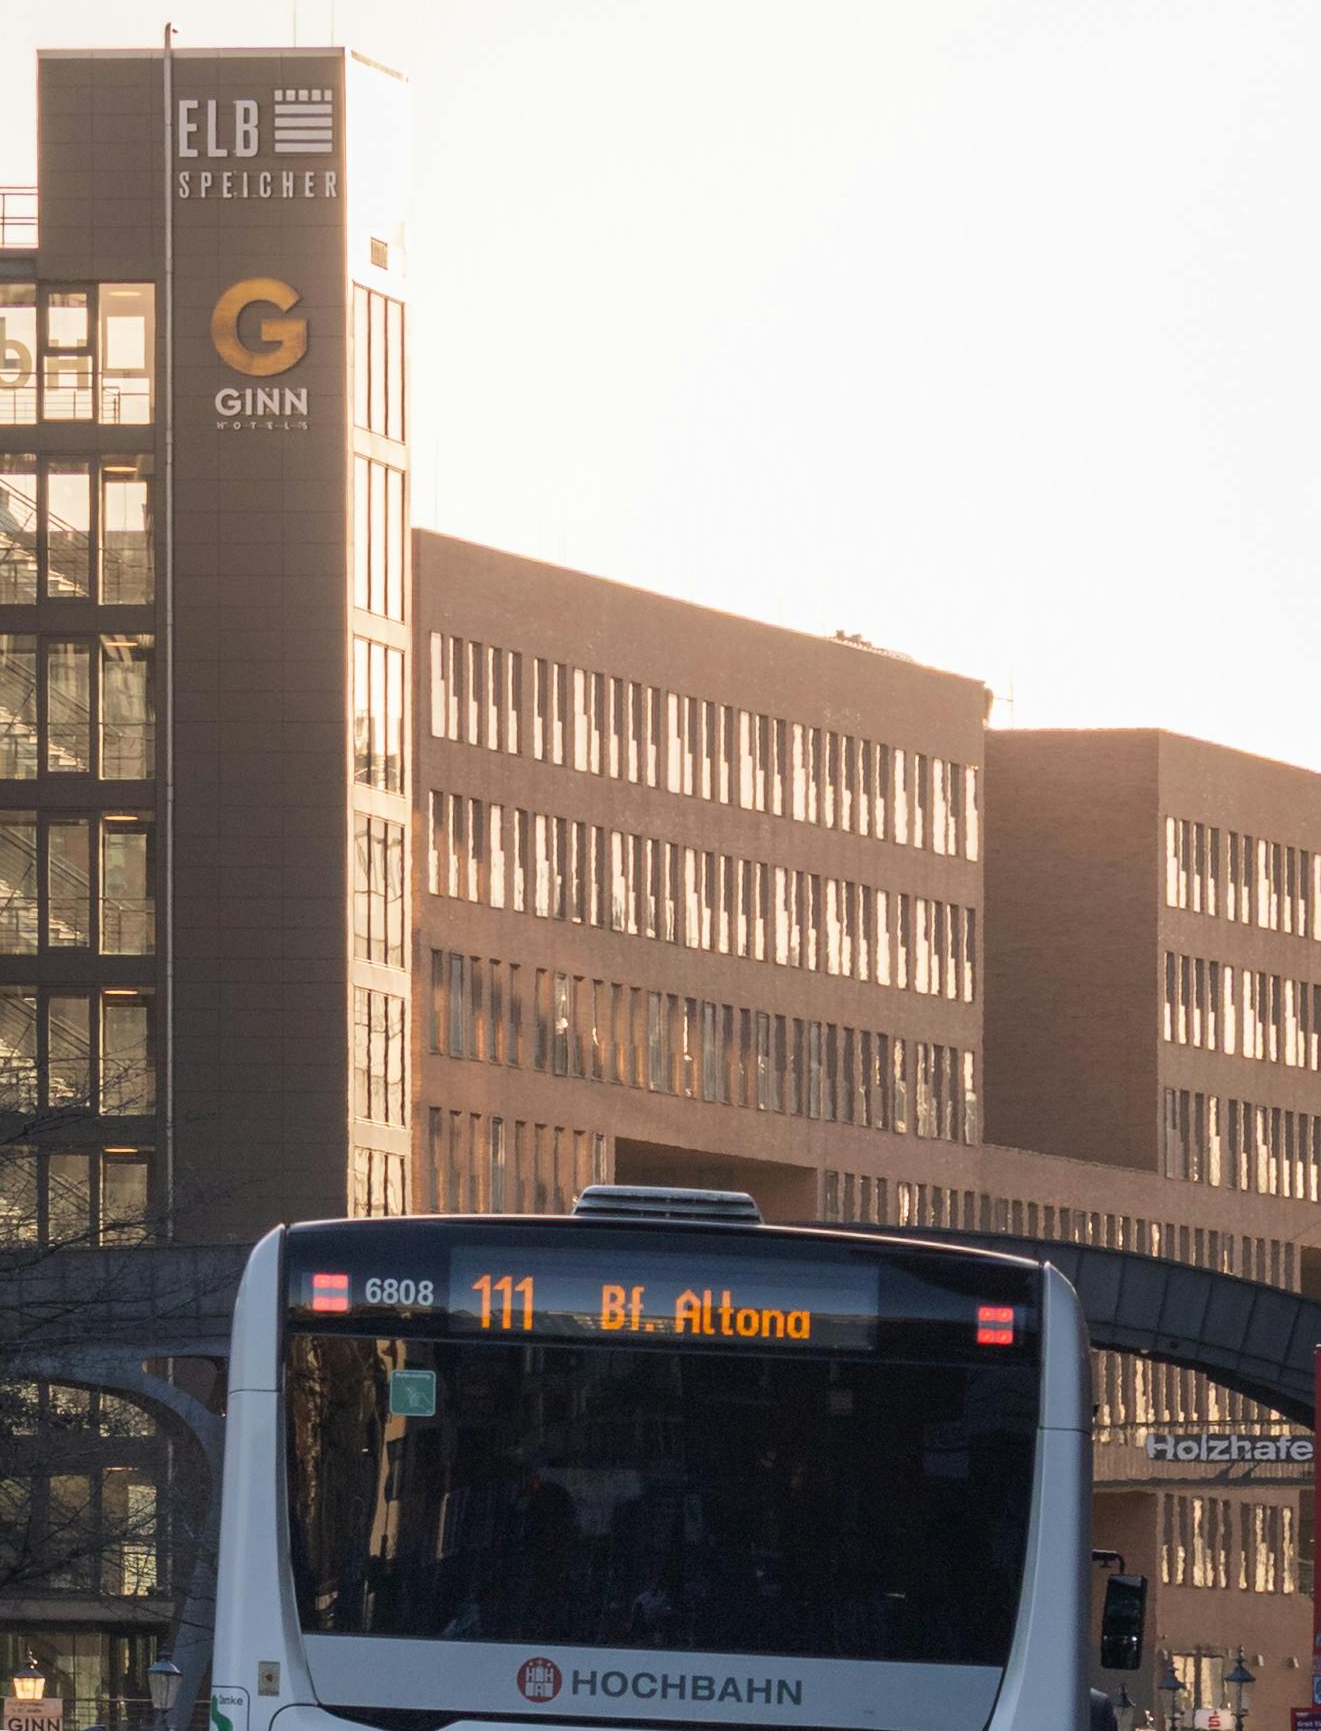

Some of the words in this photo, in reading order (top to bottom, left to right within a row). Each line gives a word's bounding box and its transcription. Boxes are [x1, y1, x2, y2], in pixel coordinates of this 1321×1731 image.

[179, 100, 259, 158] ELB
[179, 171, 337, 198] SPEICHER
[211, 277, 308, 377] G
[215, 388, 308, 416] GINN
[217, 422, 308, 430] HOTELS
[364, 1277, 434, 1307] 6808
[472, 1275, 534, 1331] 111
[601, 1284, 654, 1333] Bf.
[676, 1288, 811, 1340] Altona
[1146, 1433, 1314, 1462] Holzhafe
[572, 1670, 802, 1705] HOCHBAHN
